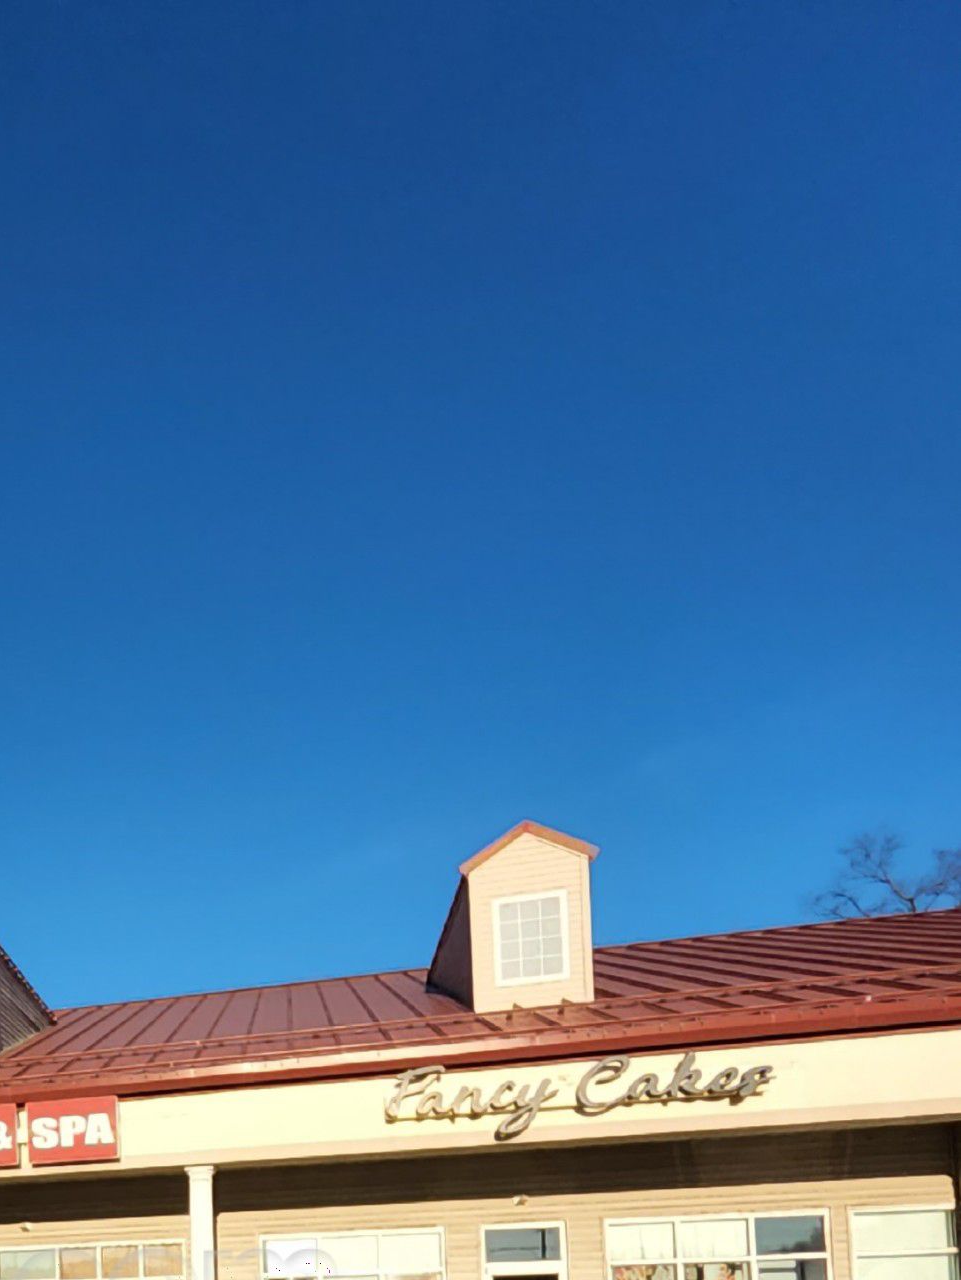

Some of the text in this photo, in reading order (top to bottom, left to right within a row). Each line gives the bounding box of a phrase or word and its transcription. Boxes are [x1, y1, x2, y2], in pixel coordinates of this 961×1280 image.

[385, 1052, 774, 1140] Fancy Cakes
[31, 1113, 115, 1149] SPA
